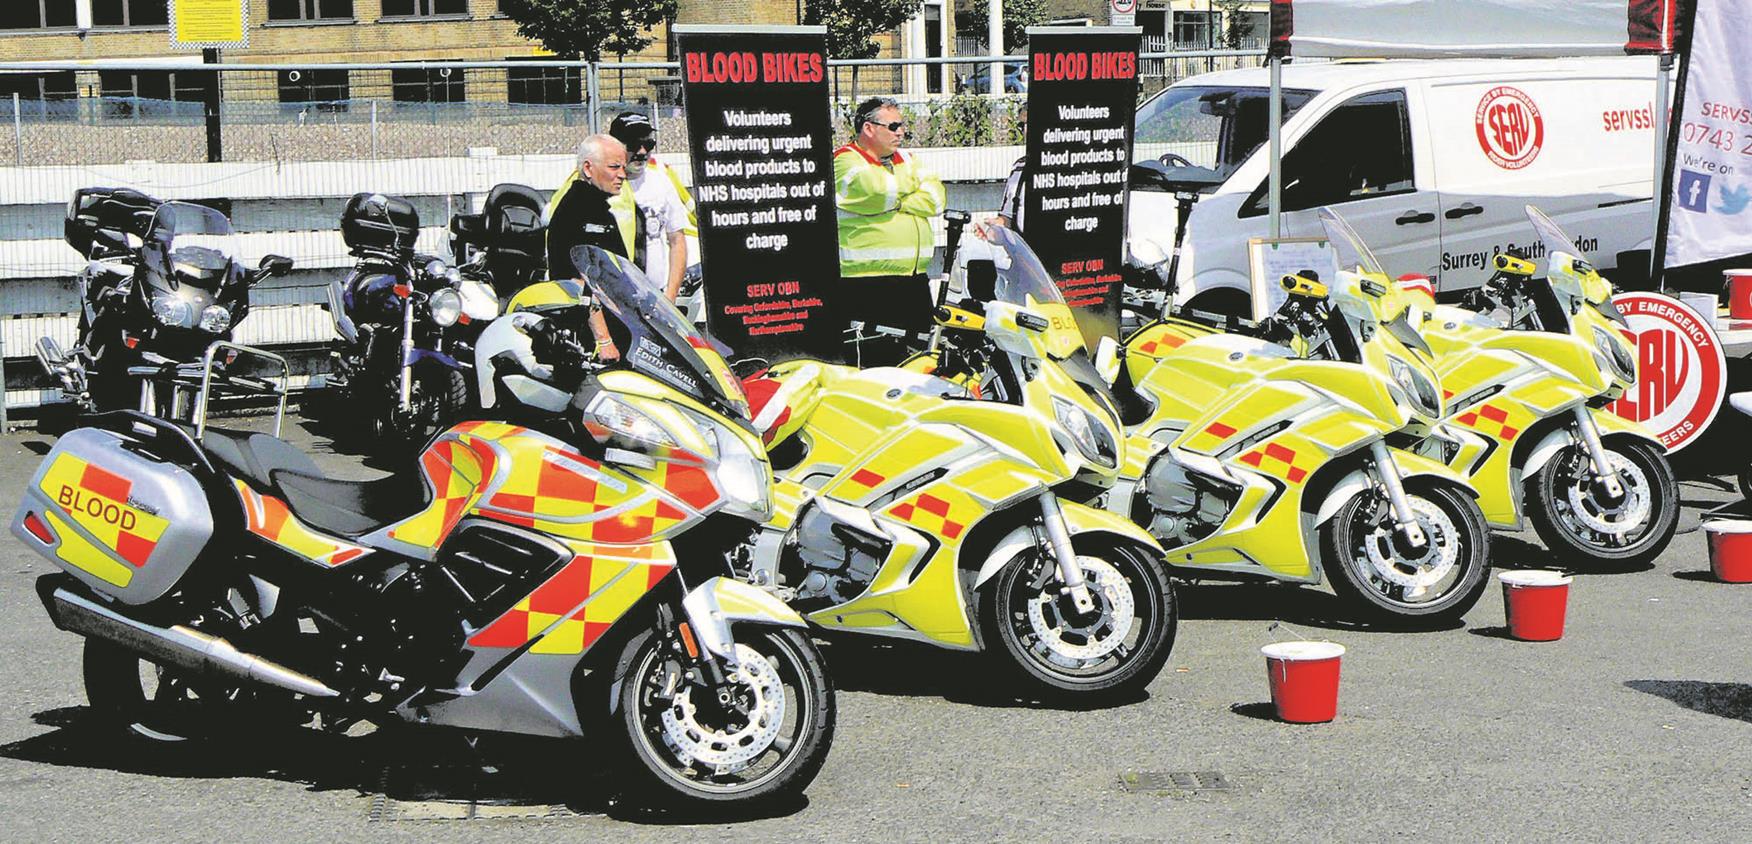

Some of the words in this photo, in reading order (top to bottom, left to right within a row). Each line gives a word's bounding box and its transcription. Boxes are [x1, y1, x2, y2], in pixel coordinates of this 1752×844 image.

[685, 52, 758, 83] BLOOD
[762, 52, 824, 83] BIKES
[1033, 52, 1088, 81] BLOOD
[1091, 51, 1136, 79] BIKES
[724, 110, 792, 127] Volunteers
[1058, 105, 1110, 120] Volunteers
[1603, 101, 1655, 132] servssl
[1701, 102, 1752, 125] SERVS
[1043, 127, 1091, 145] delivering
[1092, 126, 1125, 143] urgent
[1488, 103, 1529, 156] SERV
[1684, 122, 1735, 151] 0743
[706, 134, 769, 154] delivering
[772, 134, 812, 153] urgent
[1041, 150, 1069, 166] blood
[1070, 148, 1115, 167] products
[1116, 147, 1125, 161] to
[1683, 153, 1716, 171] We're
[705, 159, 743, 177] blood
[745, 158, 801, 179] products
[803, 158, 816, 173] to
[1033, 172, 1055, 189] NHS
[1057, 170, 1101, 189] hospitals
[1103, 169, 1121, 184] out
[699, 184, 728, 202] NHS
[731, 183, 787, 203] hospitals
[790, 182, 811, 196] out
[813, 181, 825, 196] of
[1042, 196, 1070, 211] hours
[1071, 192, 1091, 209] and
[1092, 191, 1111, 207] free
[1113, 190, 1124, 205] of
[712, 210, 749, 226] hours
[751, 207, 776, 224] and
[777, 206, 802, 223] free
[804, 205, 817, 221] of
[1065, 216, 1098, 232] charge
[746, 233, 788, 251] charge
[1442, 250, 1488, 271] Surrey
[1507, 240, 1545, 259] uth
[1571, 235, 1598, 252] don
[1061, 261, 1085, 274] SERV
[746, 283, 775, 298] SERV
[777, 281, 800, 295] OBN
[1617, 302, 1633, 314] BY
[1638, 301, 1709, 348] EMERGENCY
[635, 347, 664, 368] EDITH
[666, 364, 697, 388] CAVELL
[58, 484, 137, 531] BLOOD
